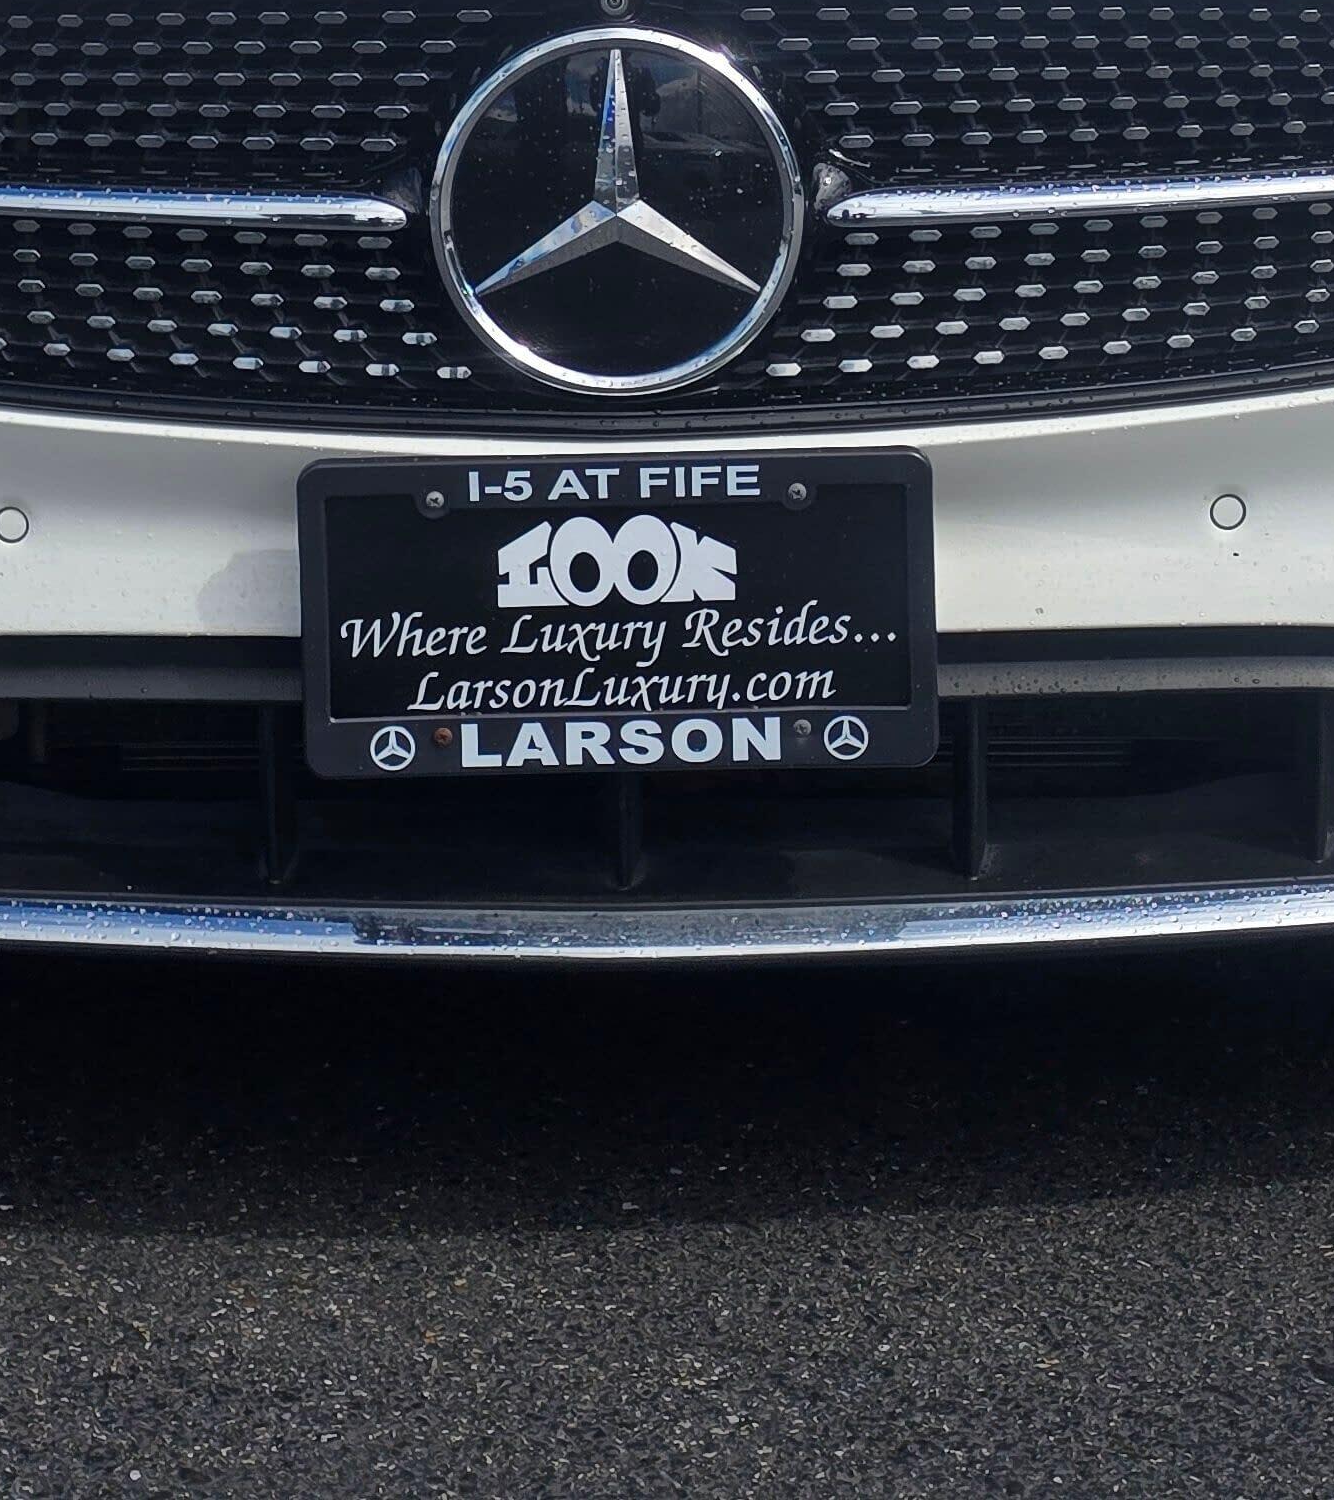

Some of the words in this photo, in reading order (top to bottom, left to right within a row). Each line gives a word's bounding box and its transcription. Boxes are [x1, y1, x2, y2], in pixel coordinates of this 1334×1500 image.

[468, 470, 533, 502] I-5
[547, 467, 620, 501] AT
[639, 464, 762, 499] FIFE
[497, 514, 738, 608] LOOK
[340, 611, 488, 658] Where
[500, 614, 667, 668] Luxury
[681, 599, 897, 657] Resides...
[406, 667, 837, 712] LarsonLuxury.com
[460, 716, 783, 768] LARSON
